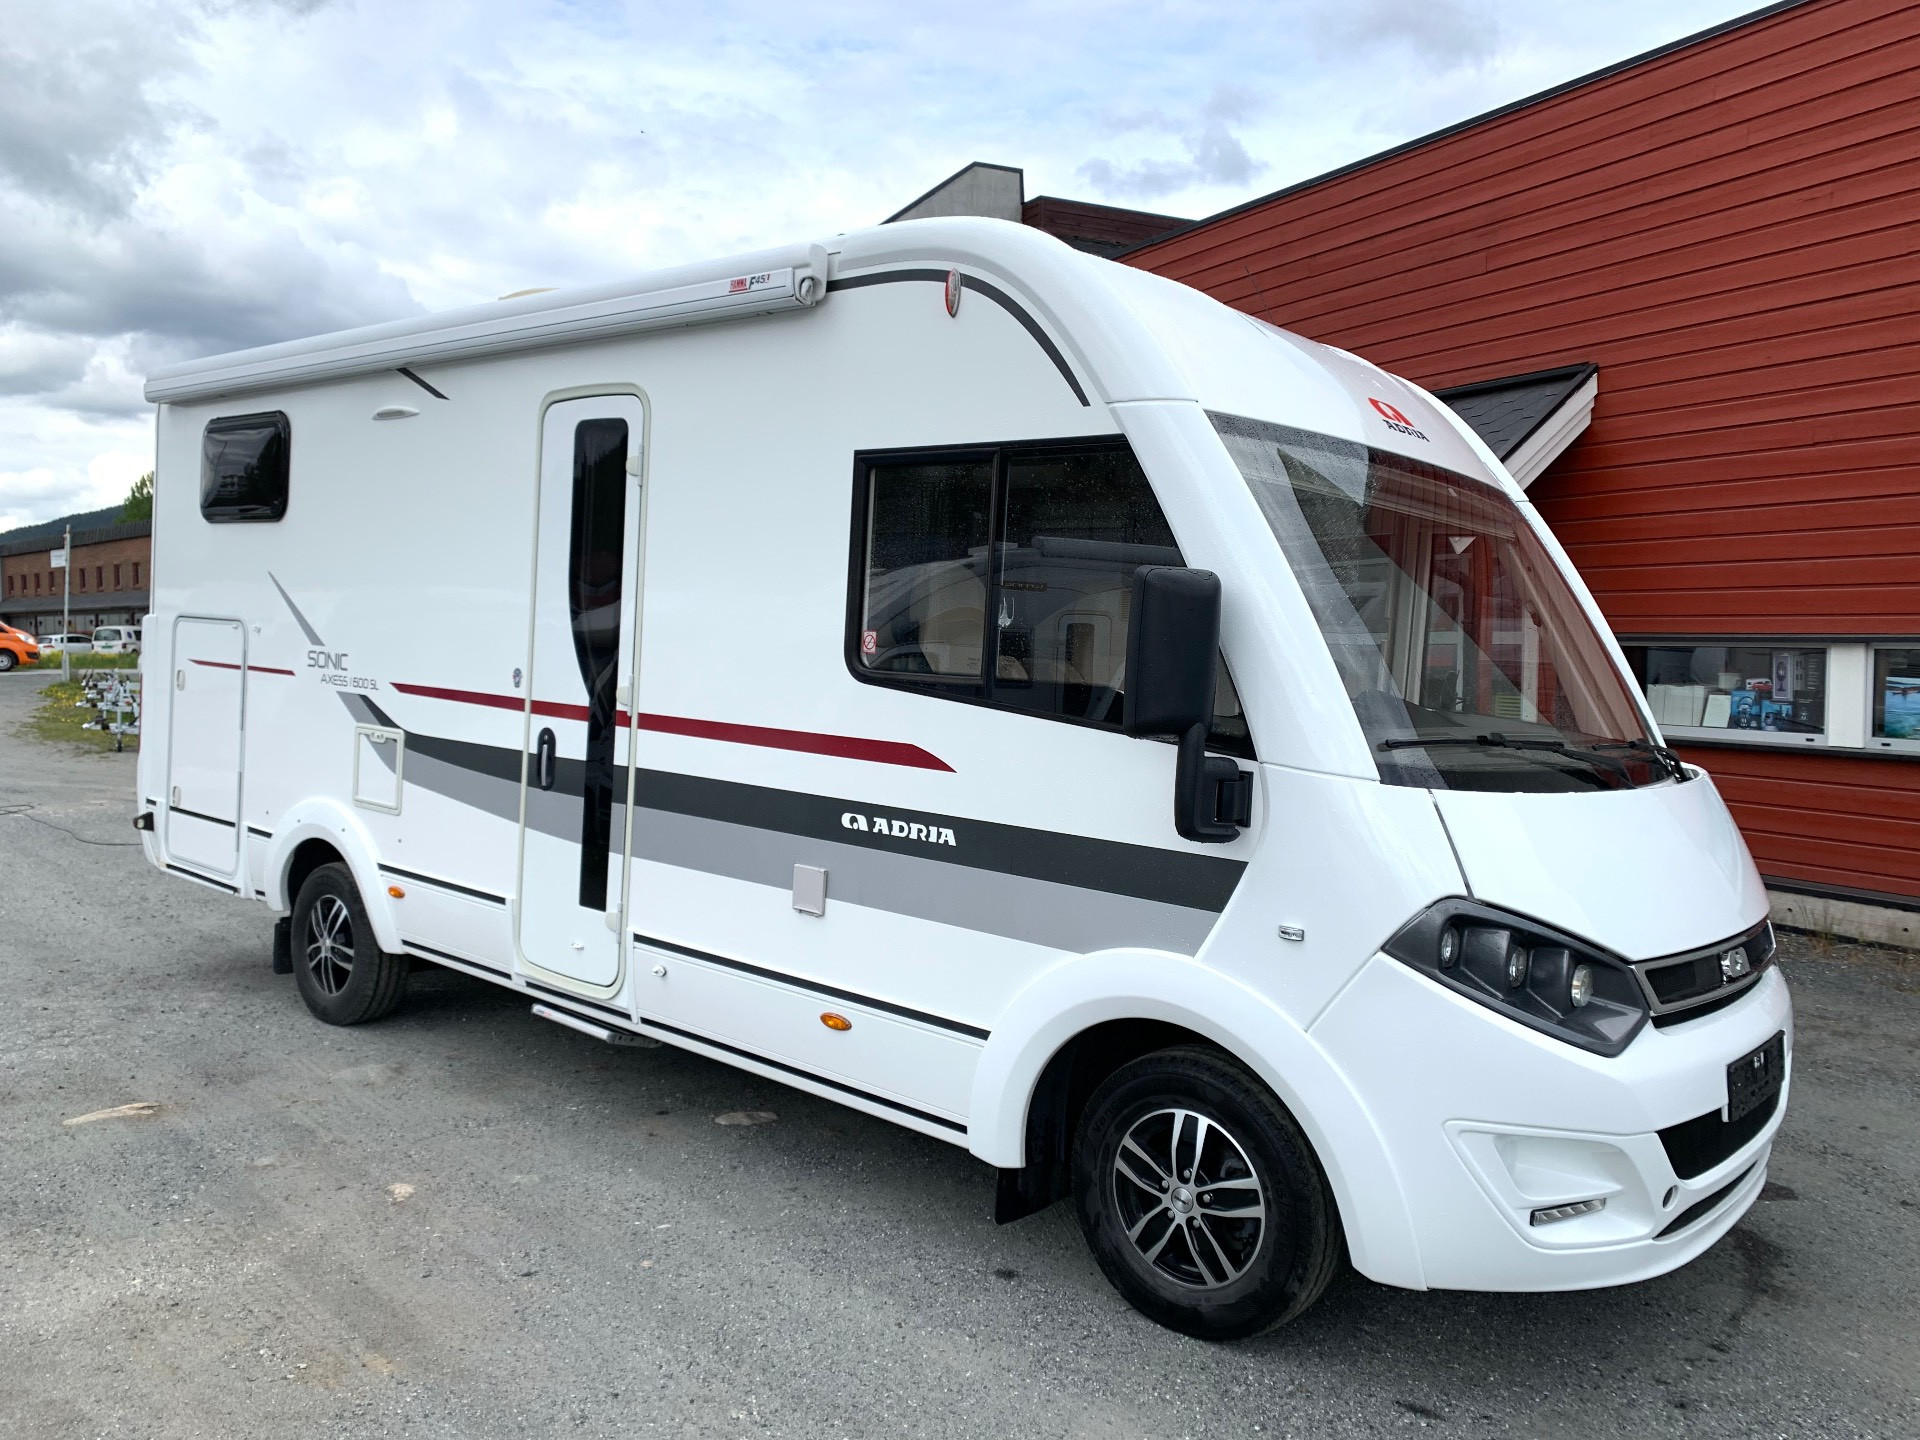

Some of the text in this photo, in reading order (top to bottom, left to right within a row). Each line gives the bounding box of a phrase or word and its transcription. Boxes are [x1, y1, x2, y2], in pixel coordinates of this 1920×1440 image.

[1382, 419, 1430, 442] ADRIA
[307, 650, 349, 671] SONIC
[320, 673, 348, 687] AXESS
[872, 816, 957, 847] ADRIA
